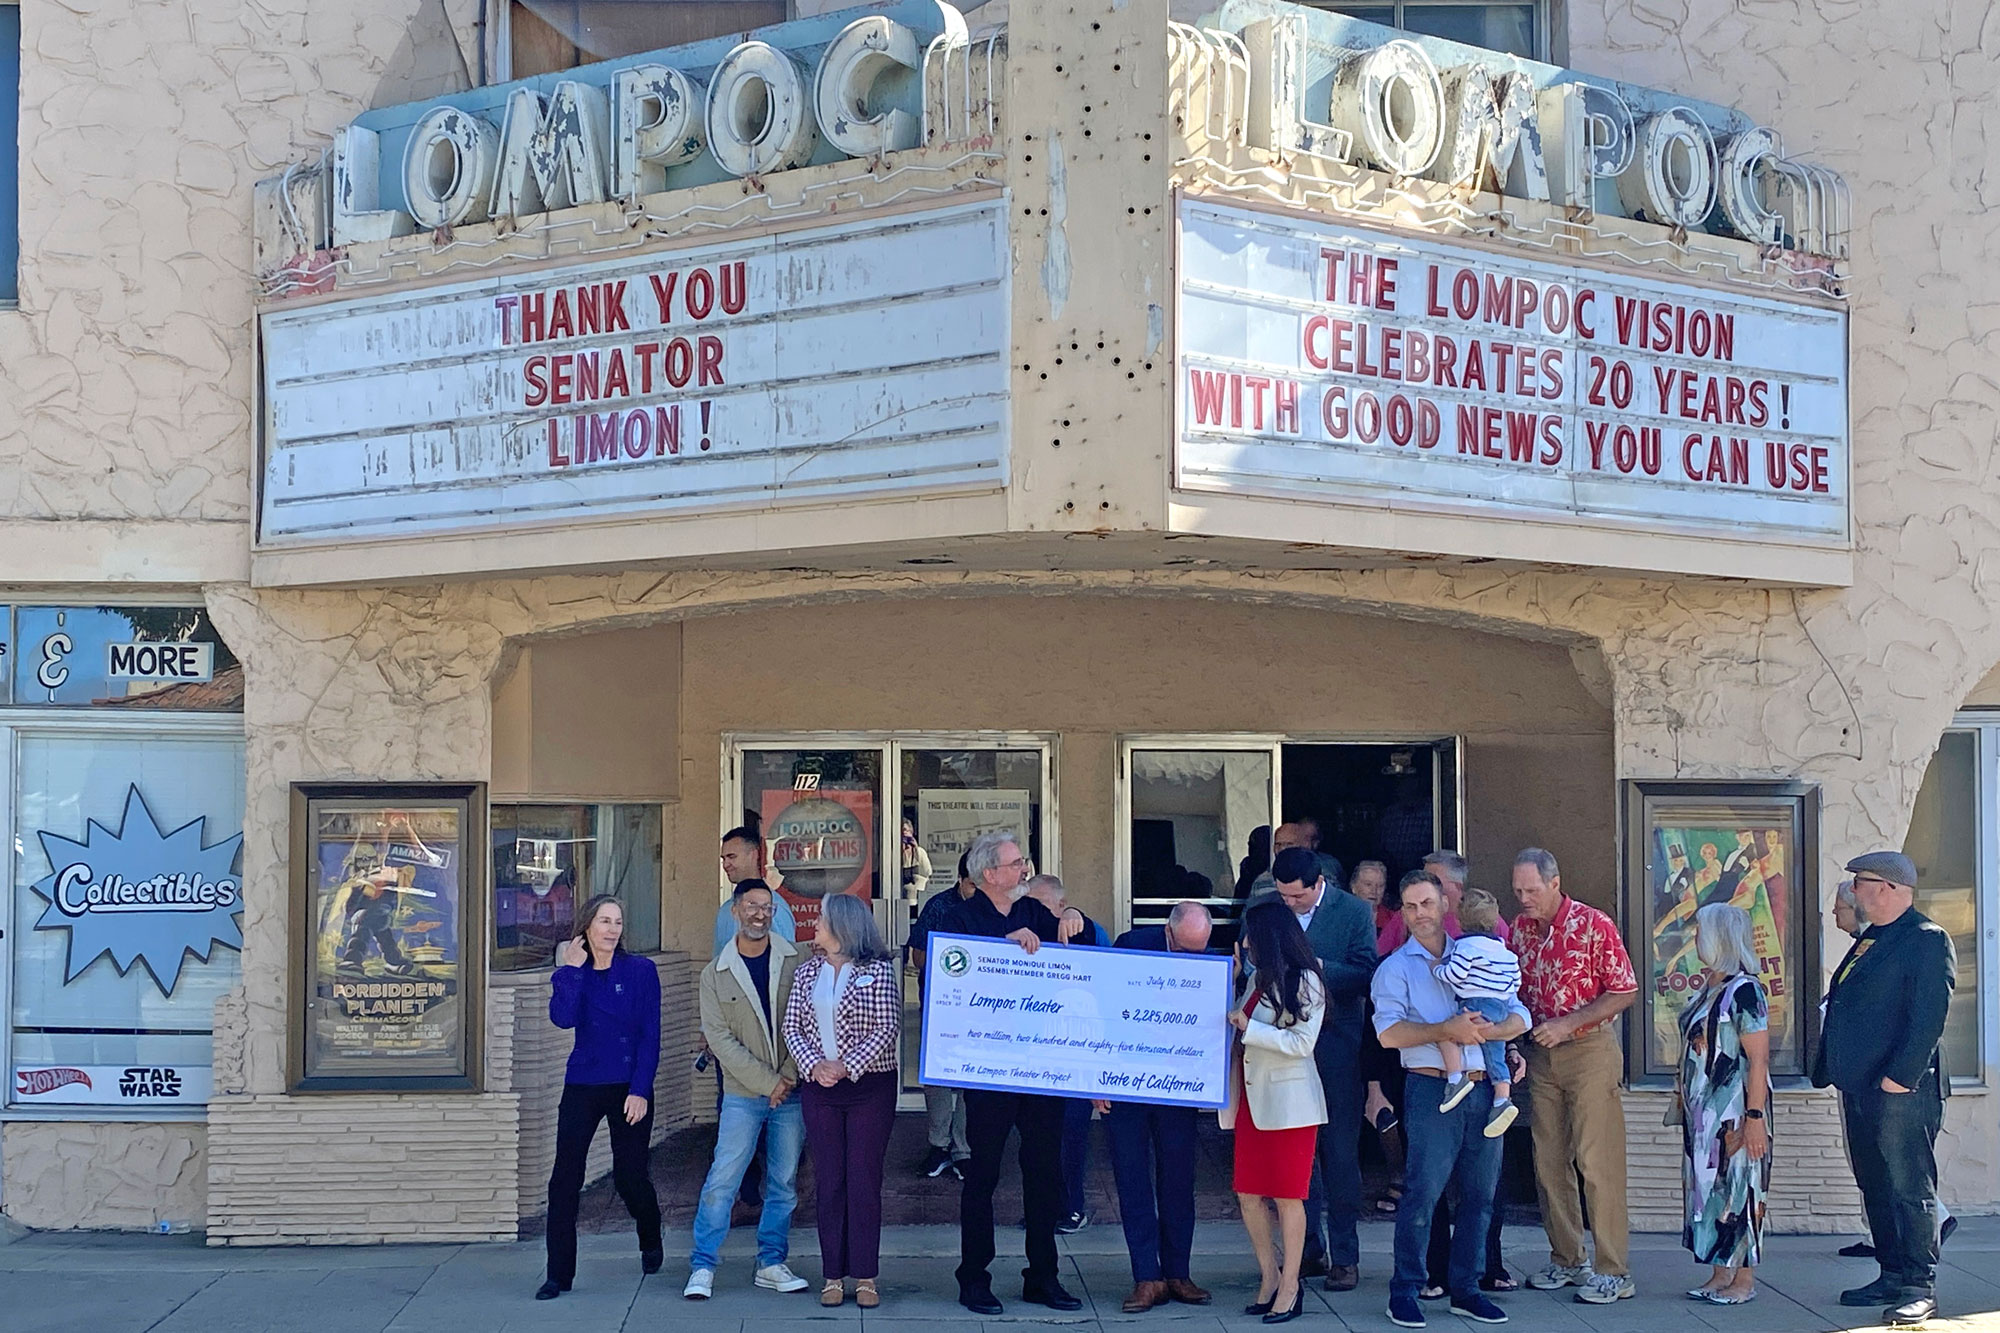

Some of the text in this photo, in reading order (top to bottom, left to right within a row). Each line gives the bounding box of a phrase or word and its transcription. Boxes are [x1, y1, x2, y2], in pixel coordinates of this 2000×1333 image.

[333, 14, 922, 245] LOMPOC
[1257, 12, 1787, 248] LOMPOC
[495, 262, 746, 345] THANK YOU
[1320, 247, 1734, 361] THE LOMPOC VISION
[523, 335, 725, 407] SENATOR
[1303, 315, 1563, 400] CELEBRATES
[1588, 356, 1634, 409] 20
[548, 405, 680, 467] LIMON
[1190, 369, 1829, 493] WITH GOOD NEWS YOU CAN USE
[110, 645, 200, 677] MORE
[796, 775, 818, 790] 112
[927, 801, 941, 810] THIS
[942, 801, 969, 810] THEATRE
[970, 801, 984, 810] WILL
[985, 802, 999, 810] RISE
[779, 820, 852, 836] LOMPOC
[774, 841, 804, 860] ET'S
[830, 841, 859, 859] THIS
[54, 862, 238, 918] Collectibles
[977, 955, 1010, 966] SENATOR
[1012, 959, 1046, 969] MONIQUE
[977, 966, 1092, 982] ASSEMBLYMEMBER GREGG HART
[1146, 976, 1202, 990] July 10, 2023
[333, 982, 443, 998] FORBIDDEN
[347, 999, 429, 1014] PLANET
[969, 992, 1065, 1014] Lompoc Theater
[967, 1028, 983, 1039] two
[984, 1030, 1013, 1043] million,
[1016, 1033, 1031, 1043] two
[1032, 1033, 1067, 1046] hundred
[1068, 1038, 1088, 1048] and
[1135, 1042, 1174, 1055] thousand
[1174, 1045, 1204, 1057] dollars
[119, 1068, 182, 1083] STAR
[961, 1062, 1072, 1084] The Lompoc Theater Project
[1098, 1070, 1205, 1093] State of California
[119, 1083, 182, 1097] WARS
